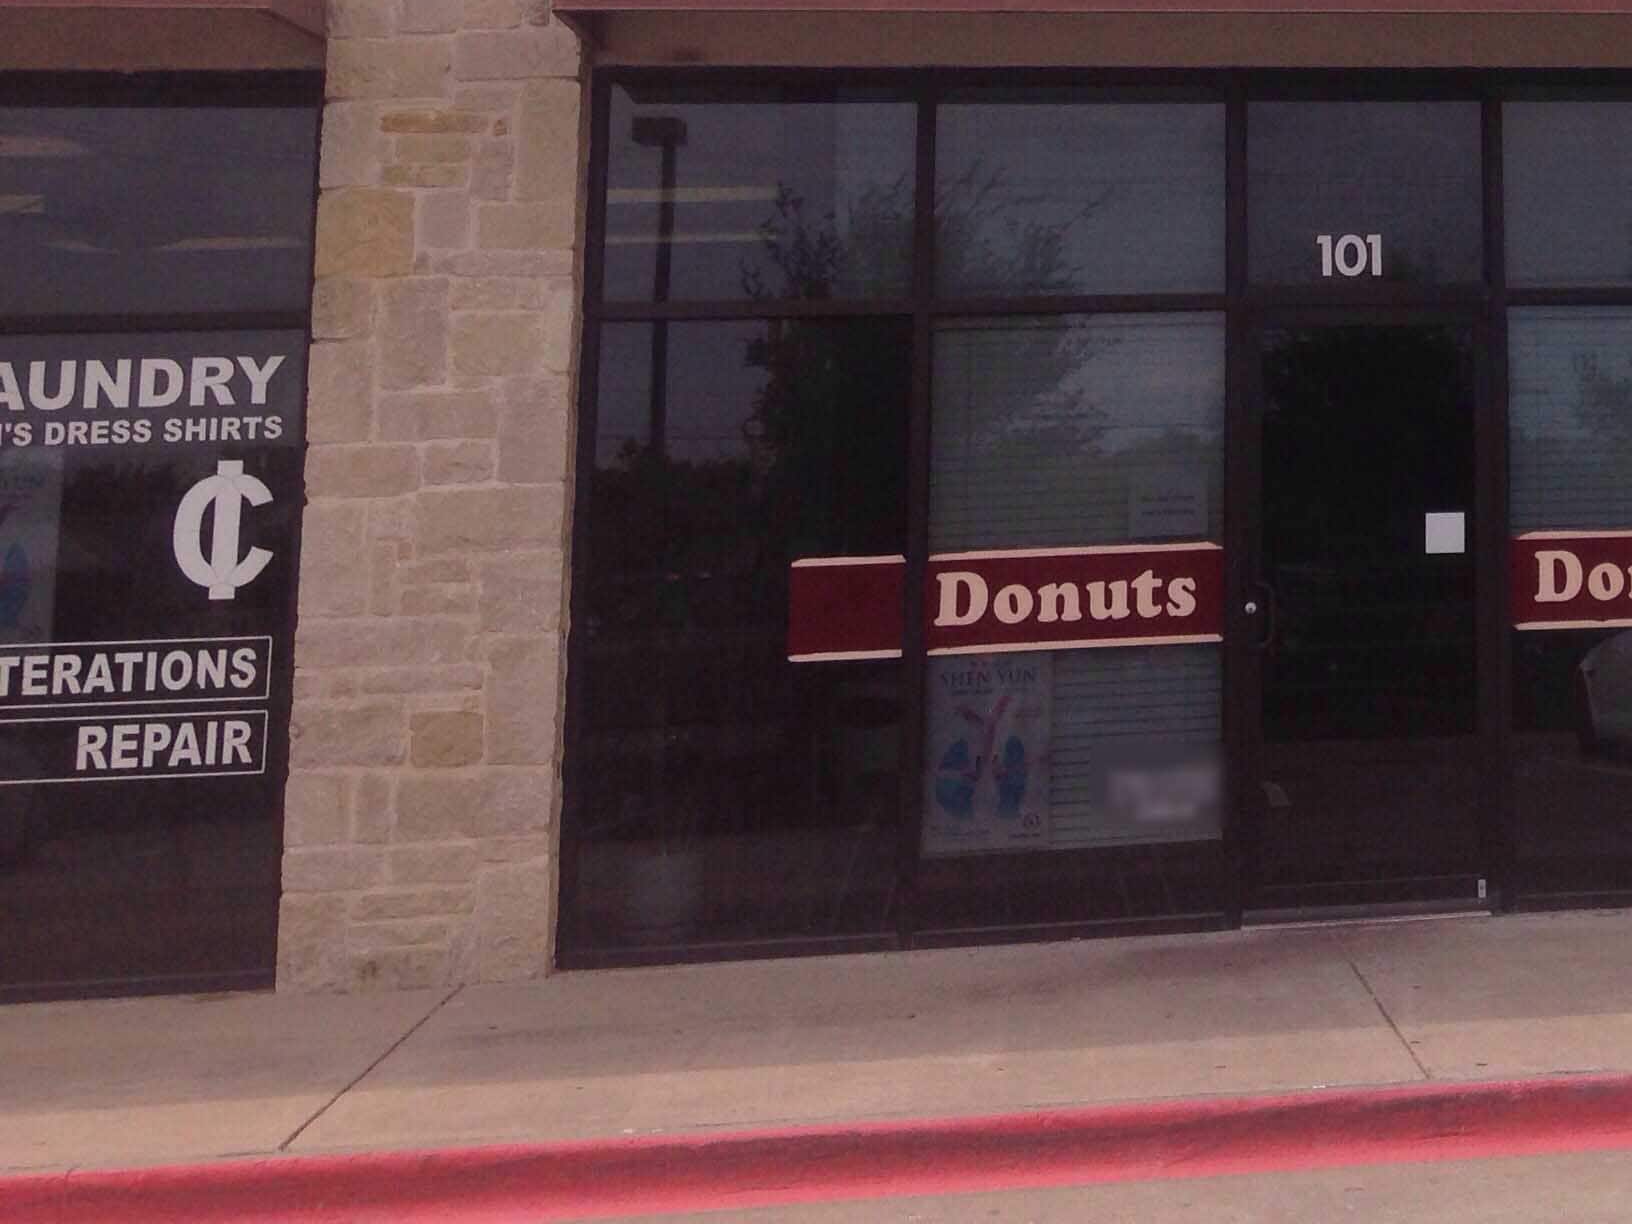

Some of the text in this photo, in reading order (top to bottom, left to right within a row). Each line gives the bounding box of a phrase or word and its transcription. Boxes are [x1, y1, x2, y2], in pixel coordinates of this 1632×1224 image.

[1316, 234, 1382, 276] 101
[0, 415, 283, 447] 'S DRESS SHIRTS
[933, 570, 1197, 627] Donuts
[0, 648, 257, 696] TERATIONS
[75, 720, 253, 771] REPAIR
